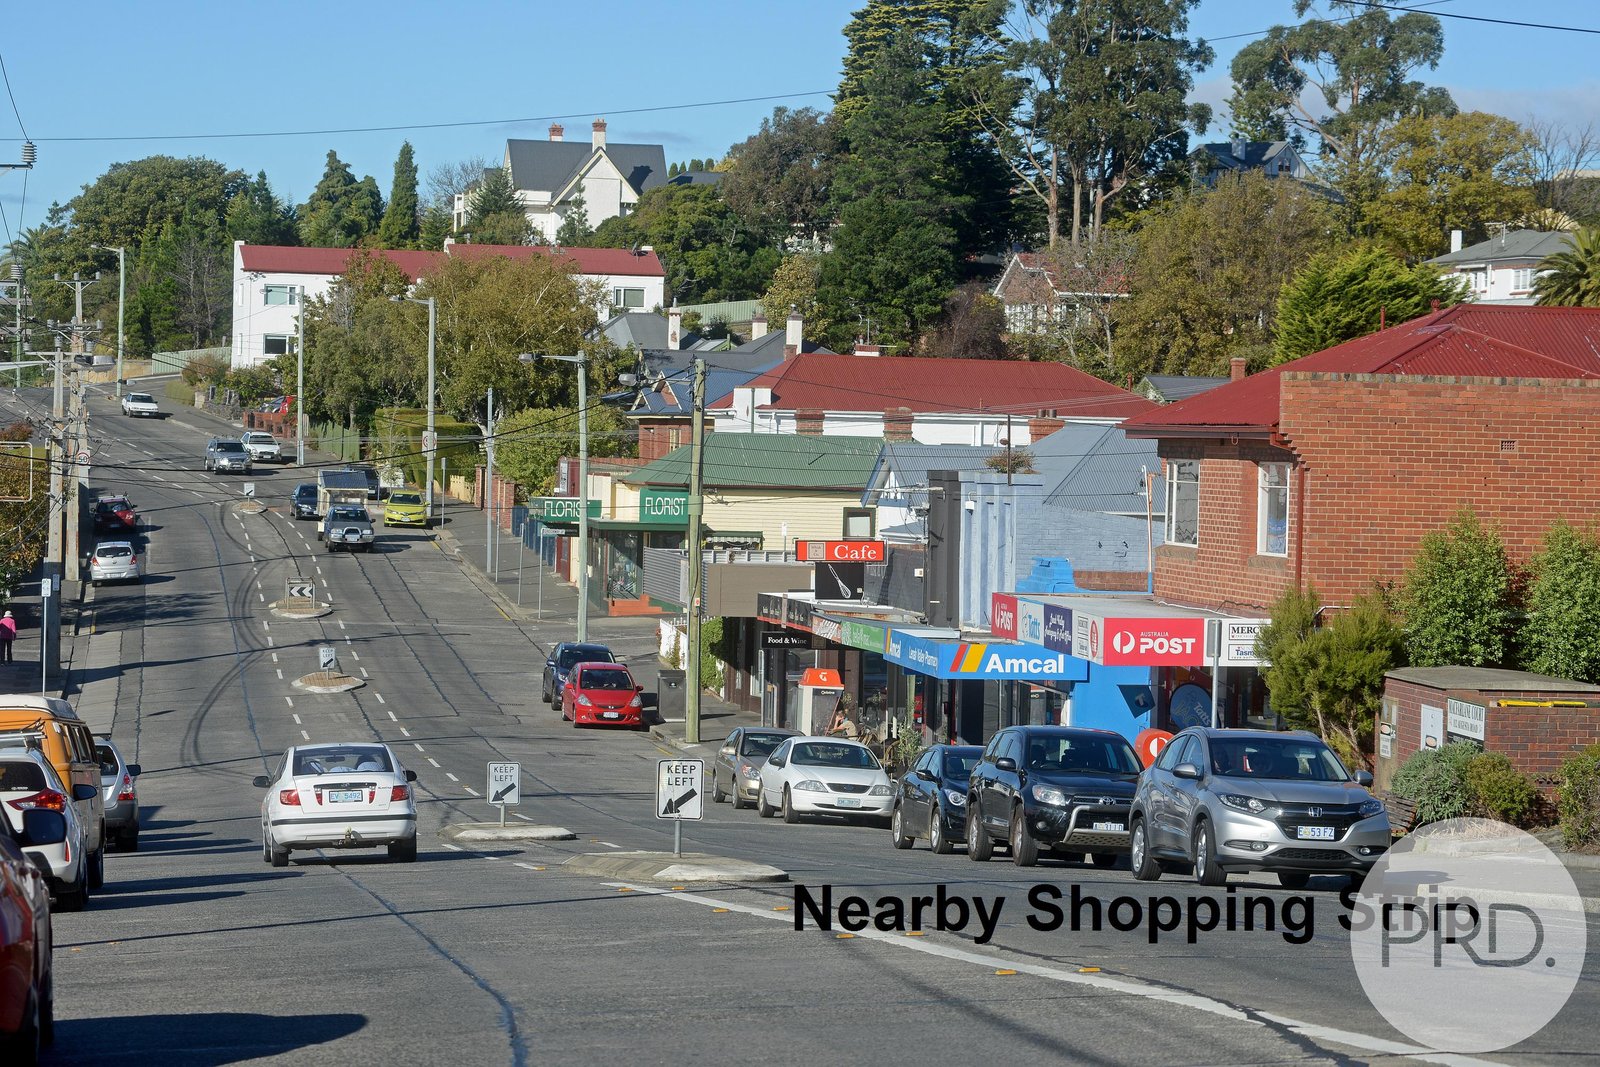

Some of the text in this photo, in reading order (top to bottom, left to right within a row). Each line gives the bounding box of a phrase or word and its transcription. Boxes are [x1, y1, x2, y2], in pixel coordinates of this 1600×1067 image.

[544, 500, 590, 518] FLORIS
[645, 497, 686, 516] FLORIST
[834, 544, 877, 559] Cafe
[1000, 610, 1013, 632] POST
[1231, 626, 1260, 634] MERC
[768, 636, 783, 644] Food
[791, 637, 807, 645] Wine
[1139, 637, 1196, 655] POST
[985, 653, 1064, 674] Amcal
[667, 765, 696, 774] KEEP
[667, 777, 694, 786] LEFT
[1298, 827, 1334, 837] E 53 FZ
